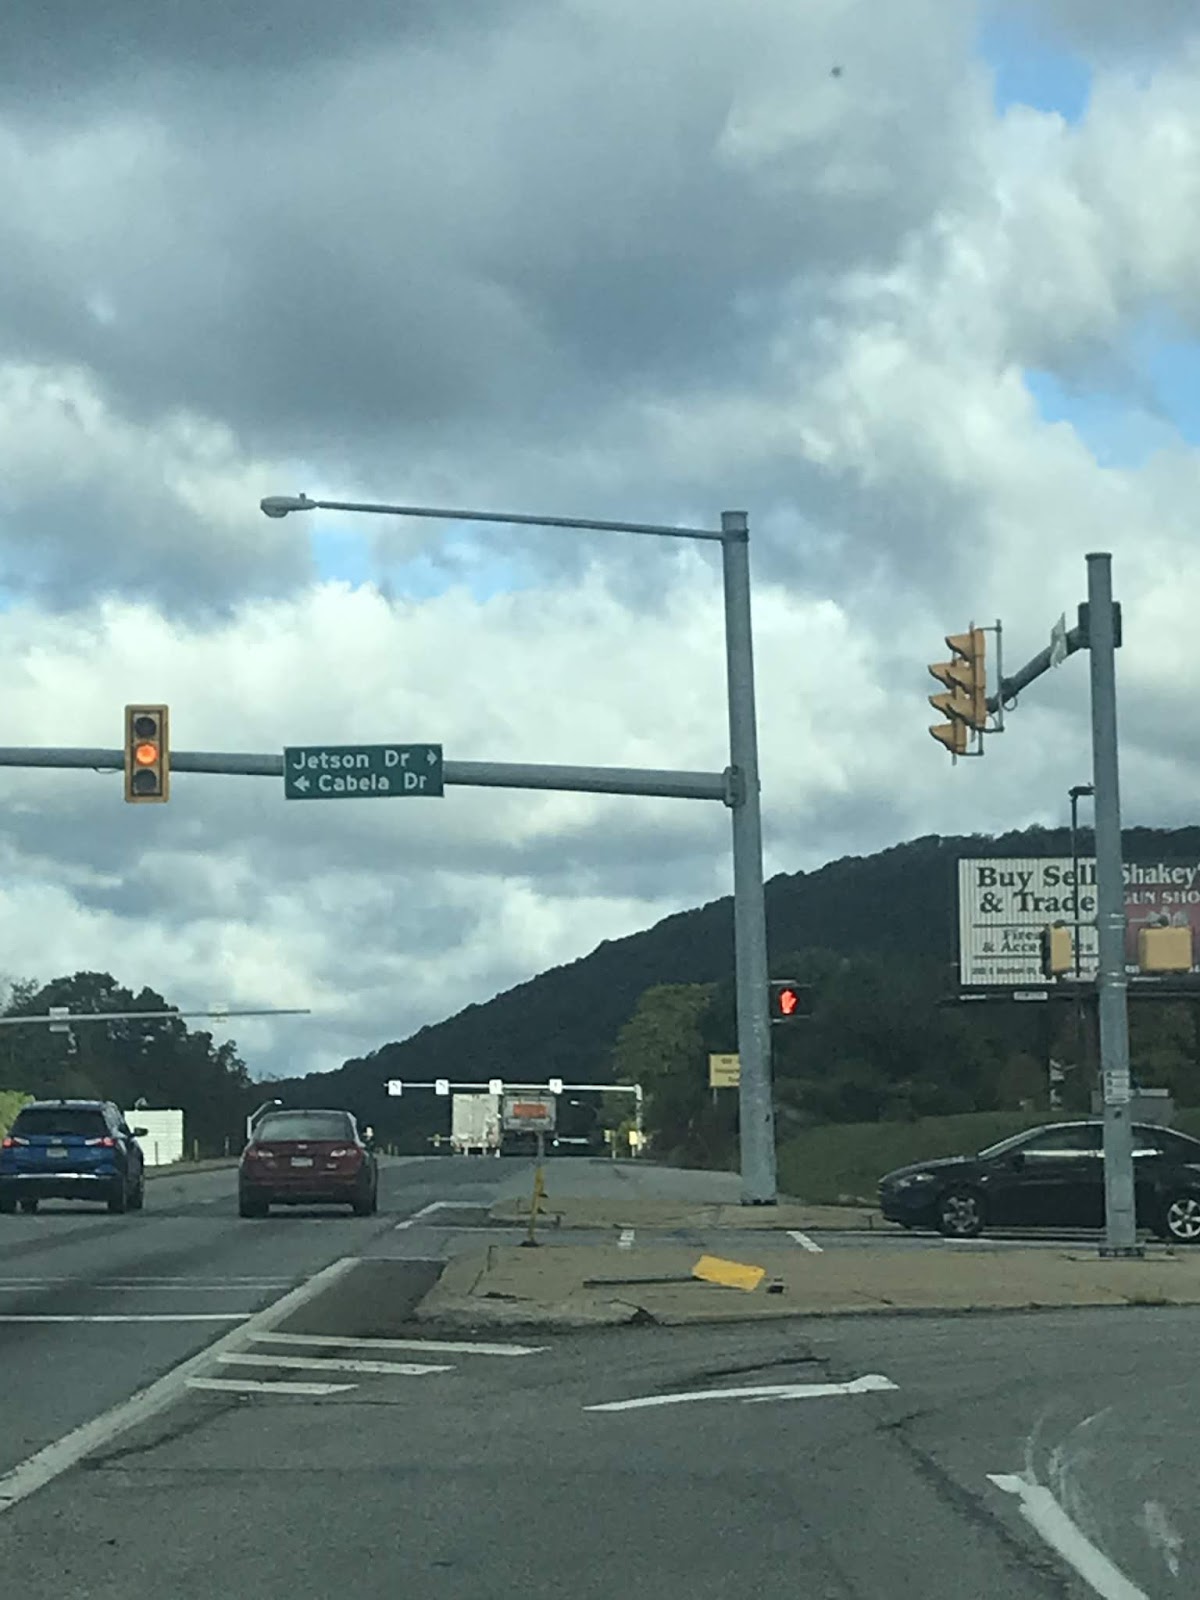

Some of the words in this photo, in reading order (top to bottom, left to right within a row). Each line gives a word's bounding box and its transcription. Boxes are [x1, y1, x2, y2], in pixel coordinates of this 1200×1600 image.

[292, 751, 370, 770] Jetson
[385, 750, 411, 767] Dr
[318, 773, 390, 792] Cabela
[404, 772, 428, 789] Dr
[977, 866, 1034, 893] Buy
[1043, 864, 1098, 888] Sell
[980, 891, 1004, 913] &
[1012, 890, 1096, 913] Trade
